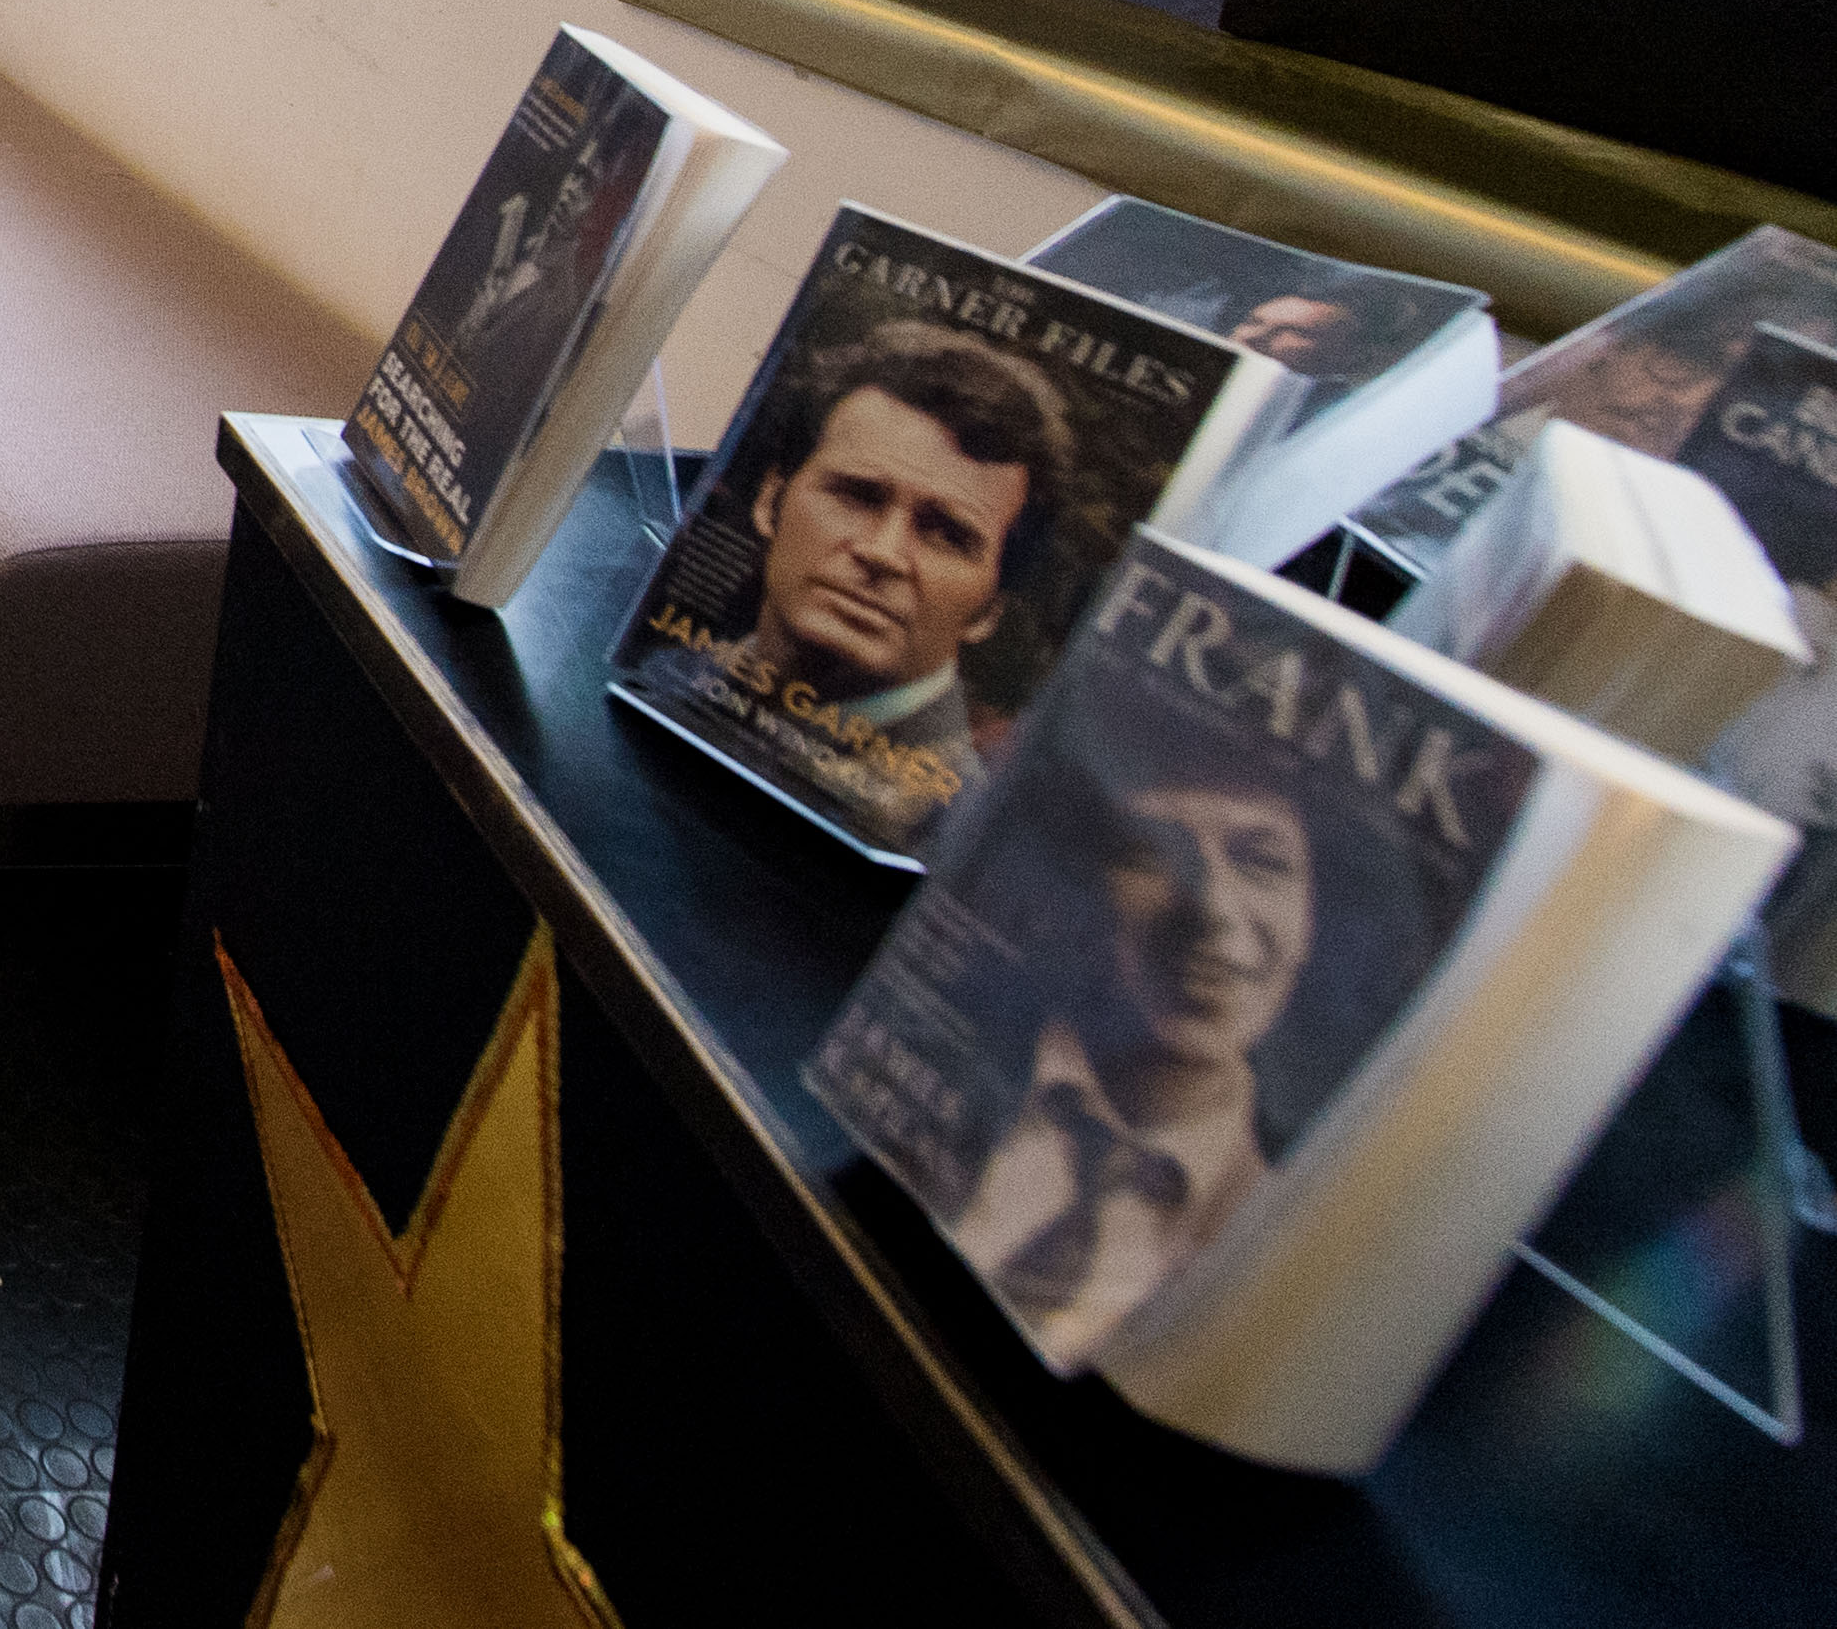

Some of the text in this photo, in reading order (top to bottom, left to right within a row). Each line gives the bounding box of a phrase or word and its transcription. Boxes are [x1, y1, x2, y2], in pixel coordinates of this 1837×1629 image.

[833, 241, 1195, 406] GARNER FILES
[648, 602, 965, 808] JAMES GARNER
[1097, 564, 1475, 848] FRANK
